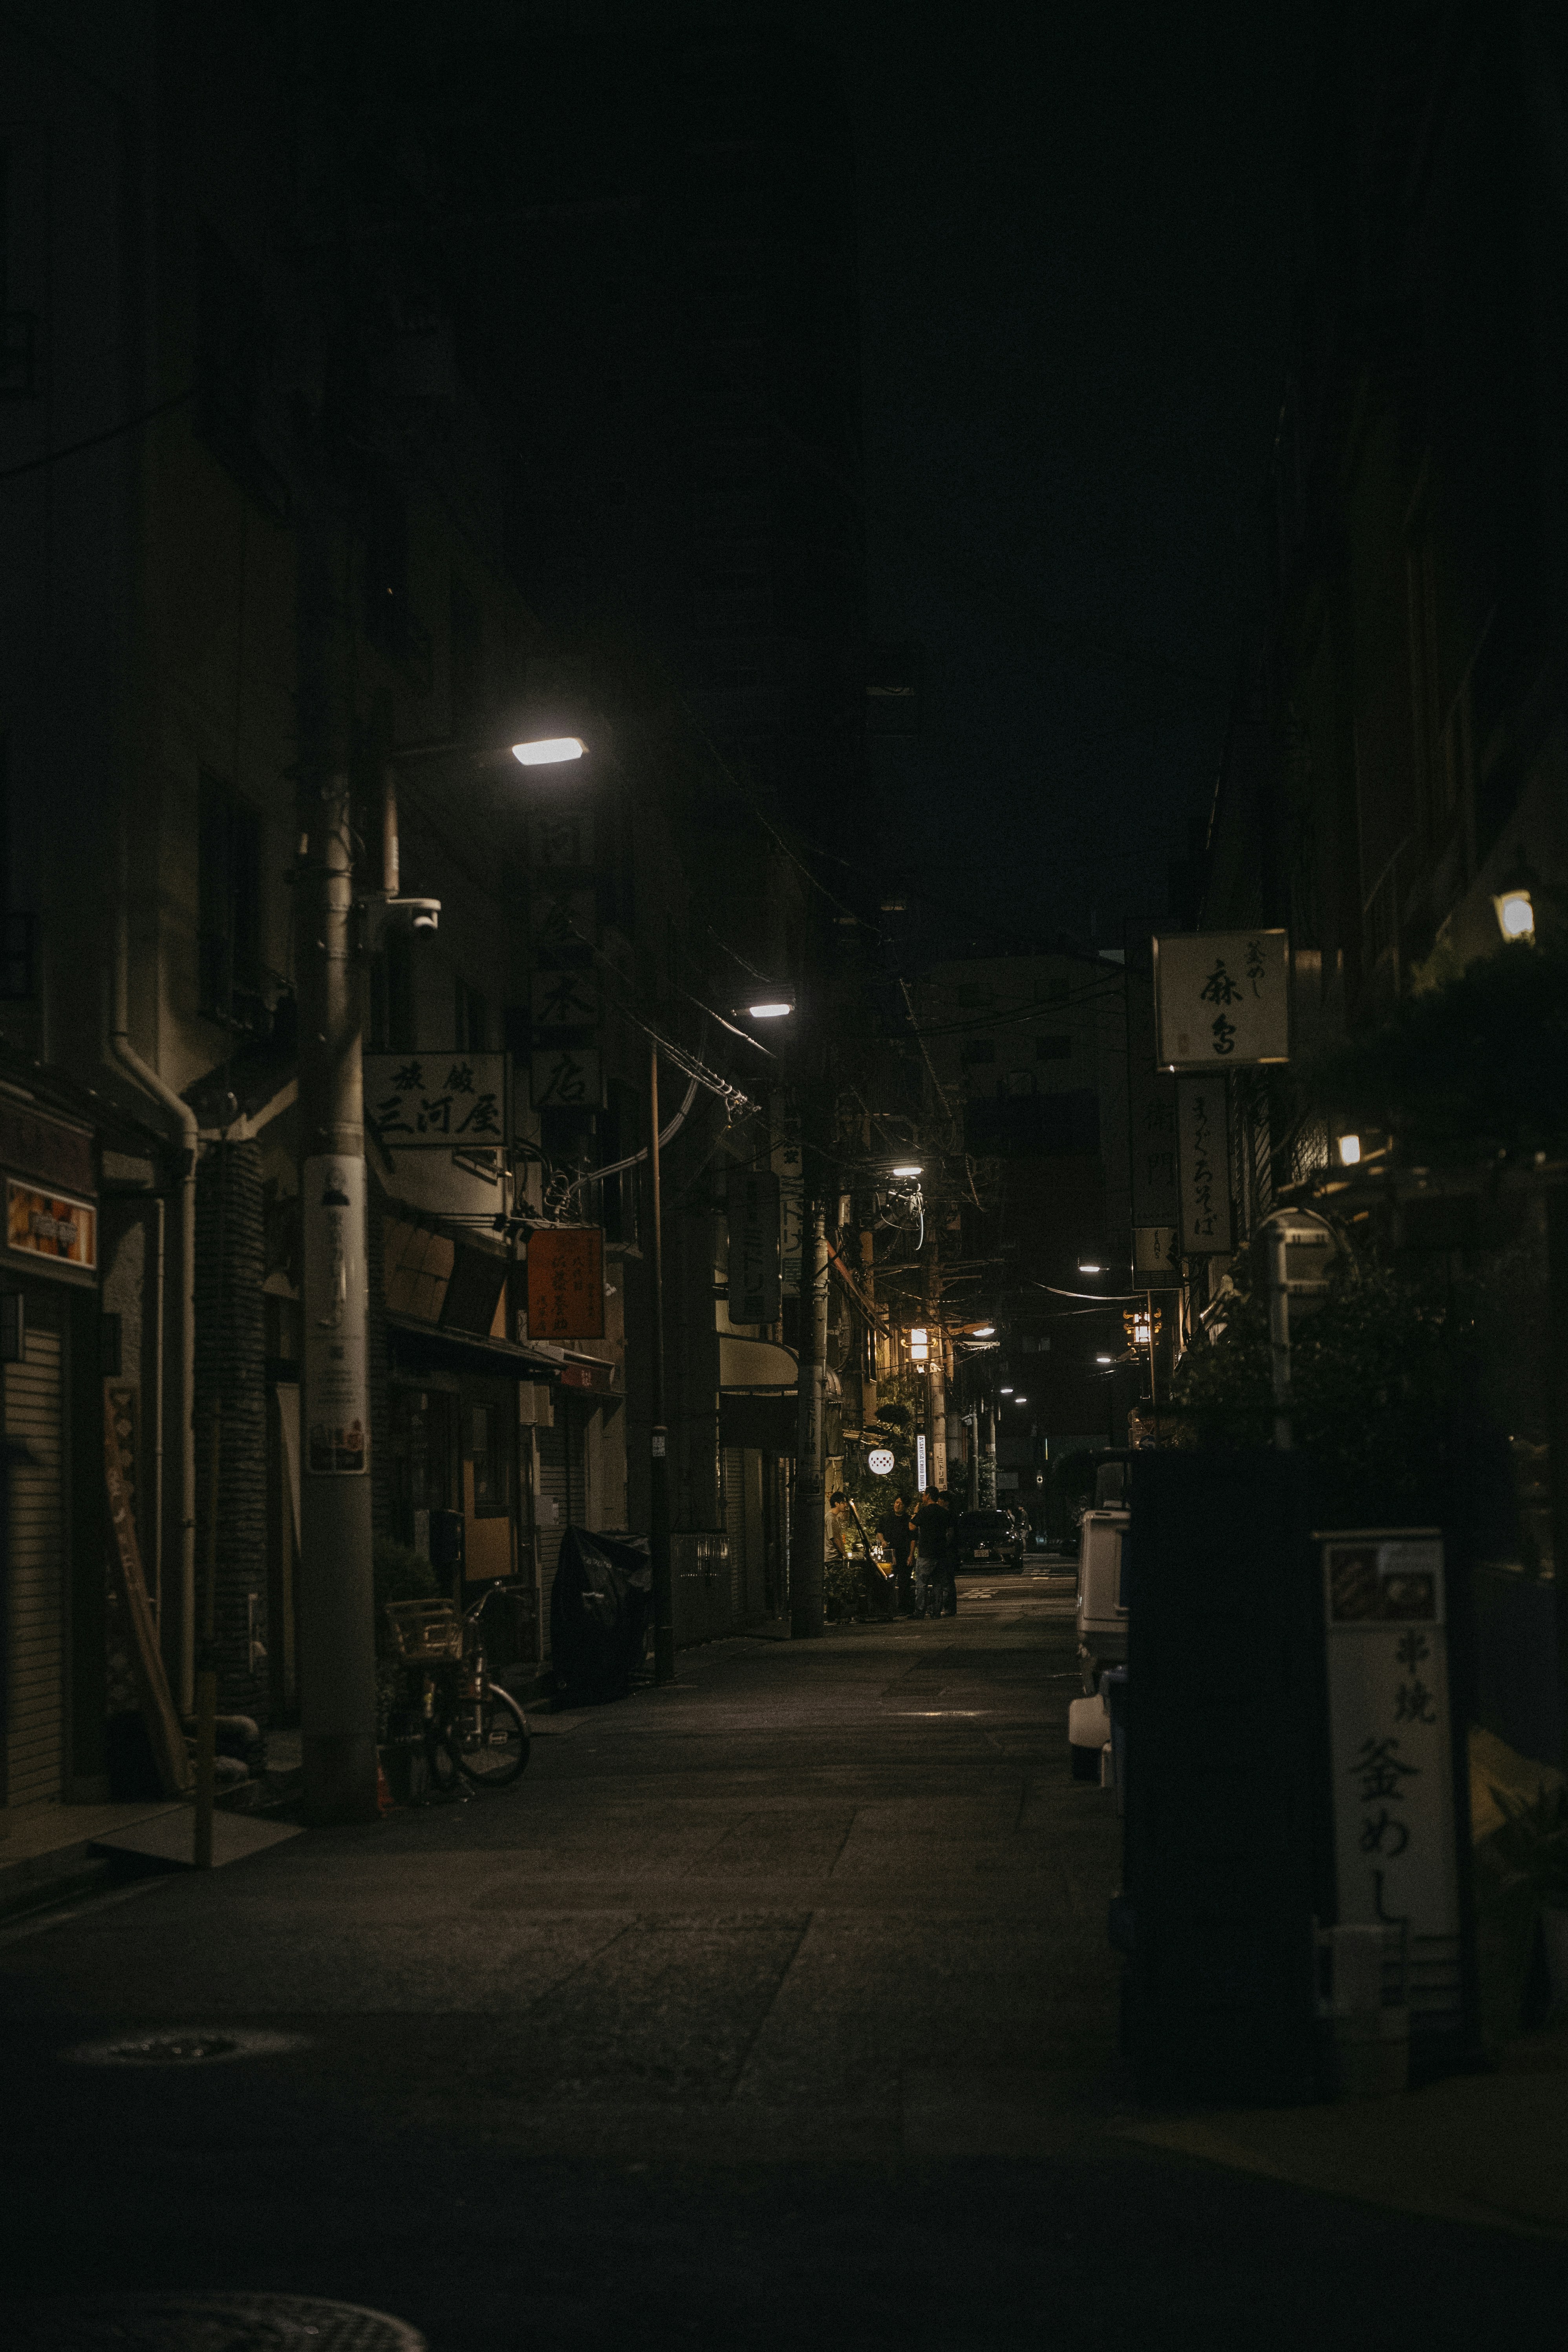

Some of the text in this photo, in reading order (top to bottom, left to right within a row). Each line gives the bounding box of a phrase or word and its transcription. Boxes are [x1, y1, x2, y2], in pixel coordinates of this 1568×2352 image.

[377, 1093, 501, 1134] 三河屋
[1193, 1096, 1217, 1236] まぐろそば
[1395, 1629, 1436, 1725] 串焼
[1348, 1737, 1420, 1923] 釜めし
